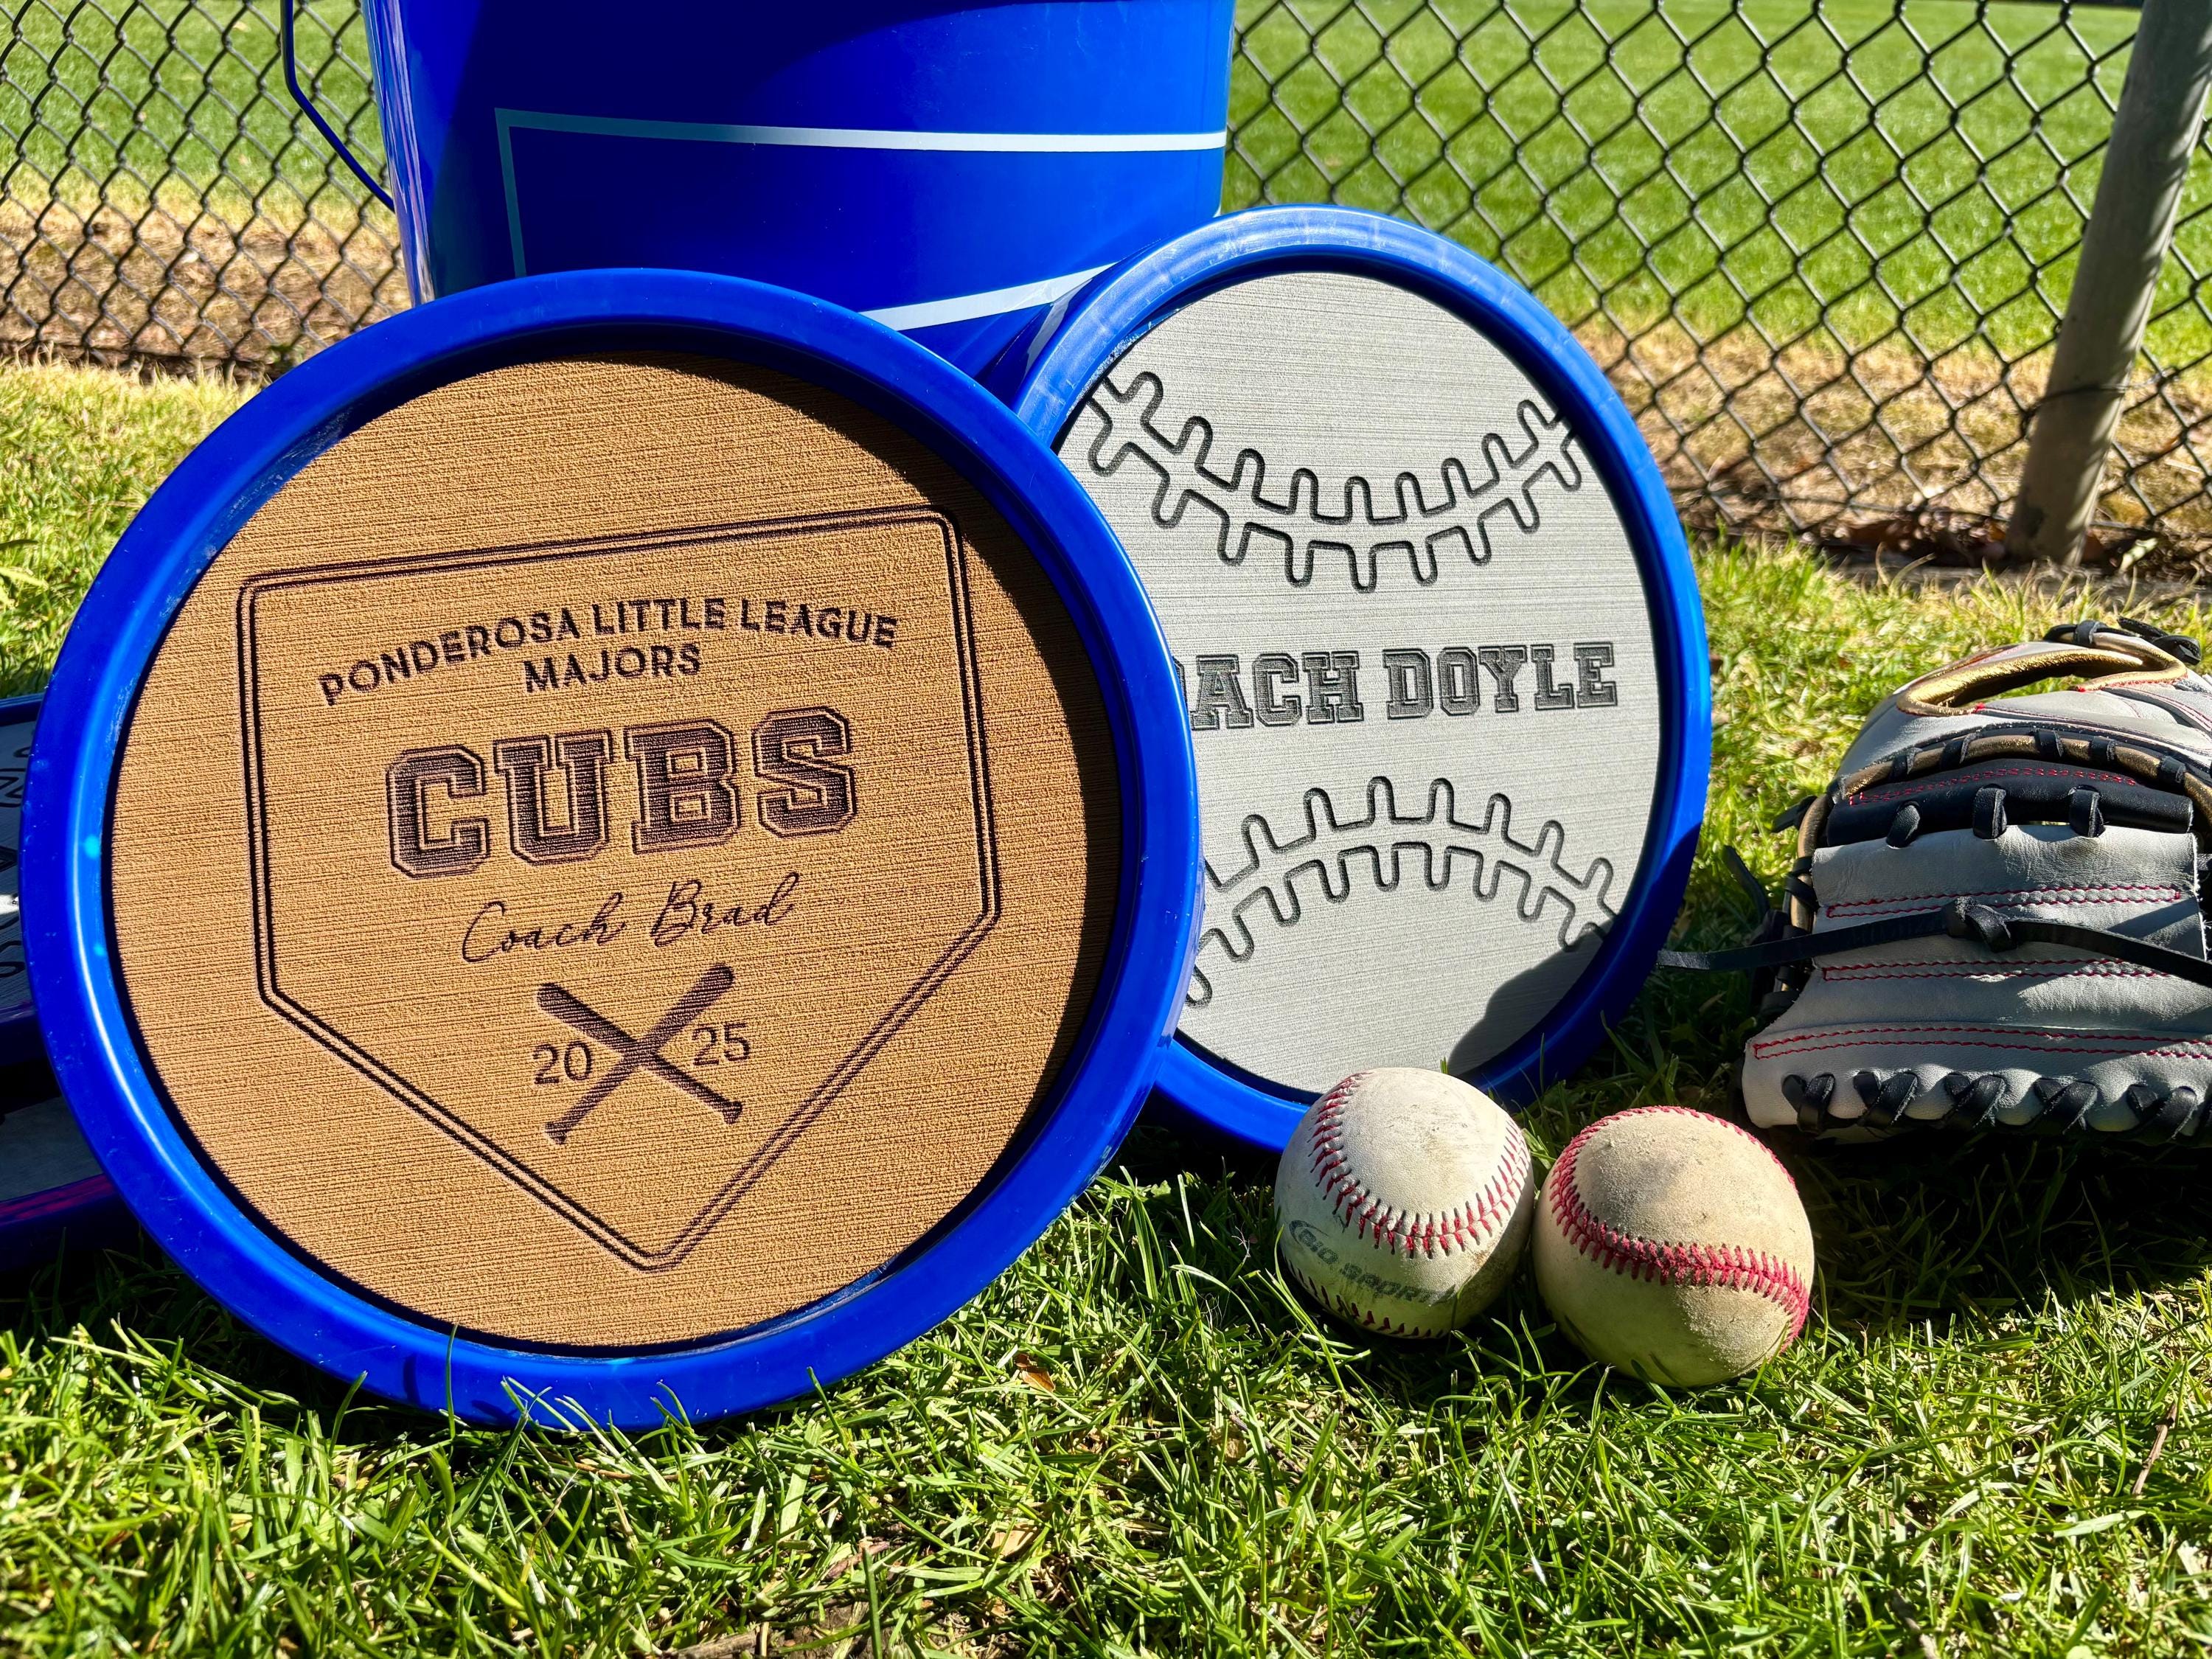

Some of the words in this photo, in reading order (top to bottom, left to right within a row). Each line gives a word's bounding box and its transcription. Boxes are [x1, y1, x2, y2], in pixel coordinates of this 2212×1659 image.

[318, 608, 580, 706] PONDEROSA
[591, 597, 726, 637] LITTLE
[740, 597, 899, 650] LEAGUE
[523, 642, 702, 694] MAJORS
[1172, 650, 1364, 731] ACH
[1382, 641, 1618, 721] DOYLE
[385, 704, 860, 880] CUBS
[461, 891, 627, 963] Coach
[648, 872, 801, 947] Brad
[532, 1040, 594, 1085] 20
[690, 1021, 752, 1066] 25
